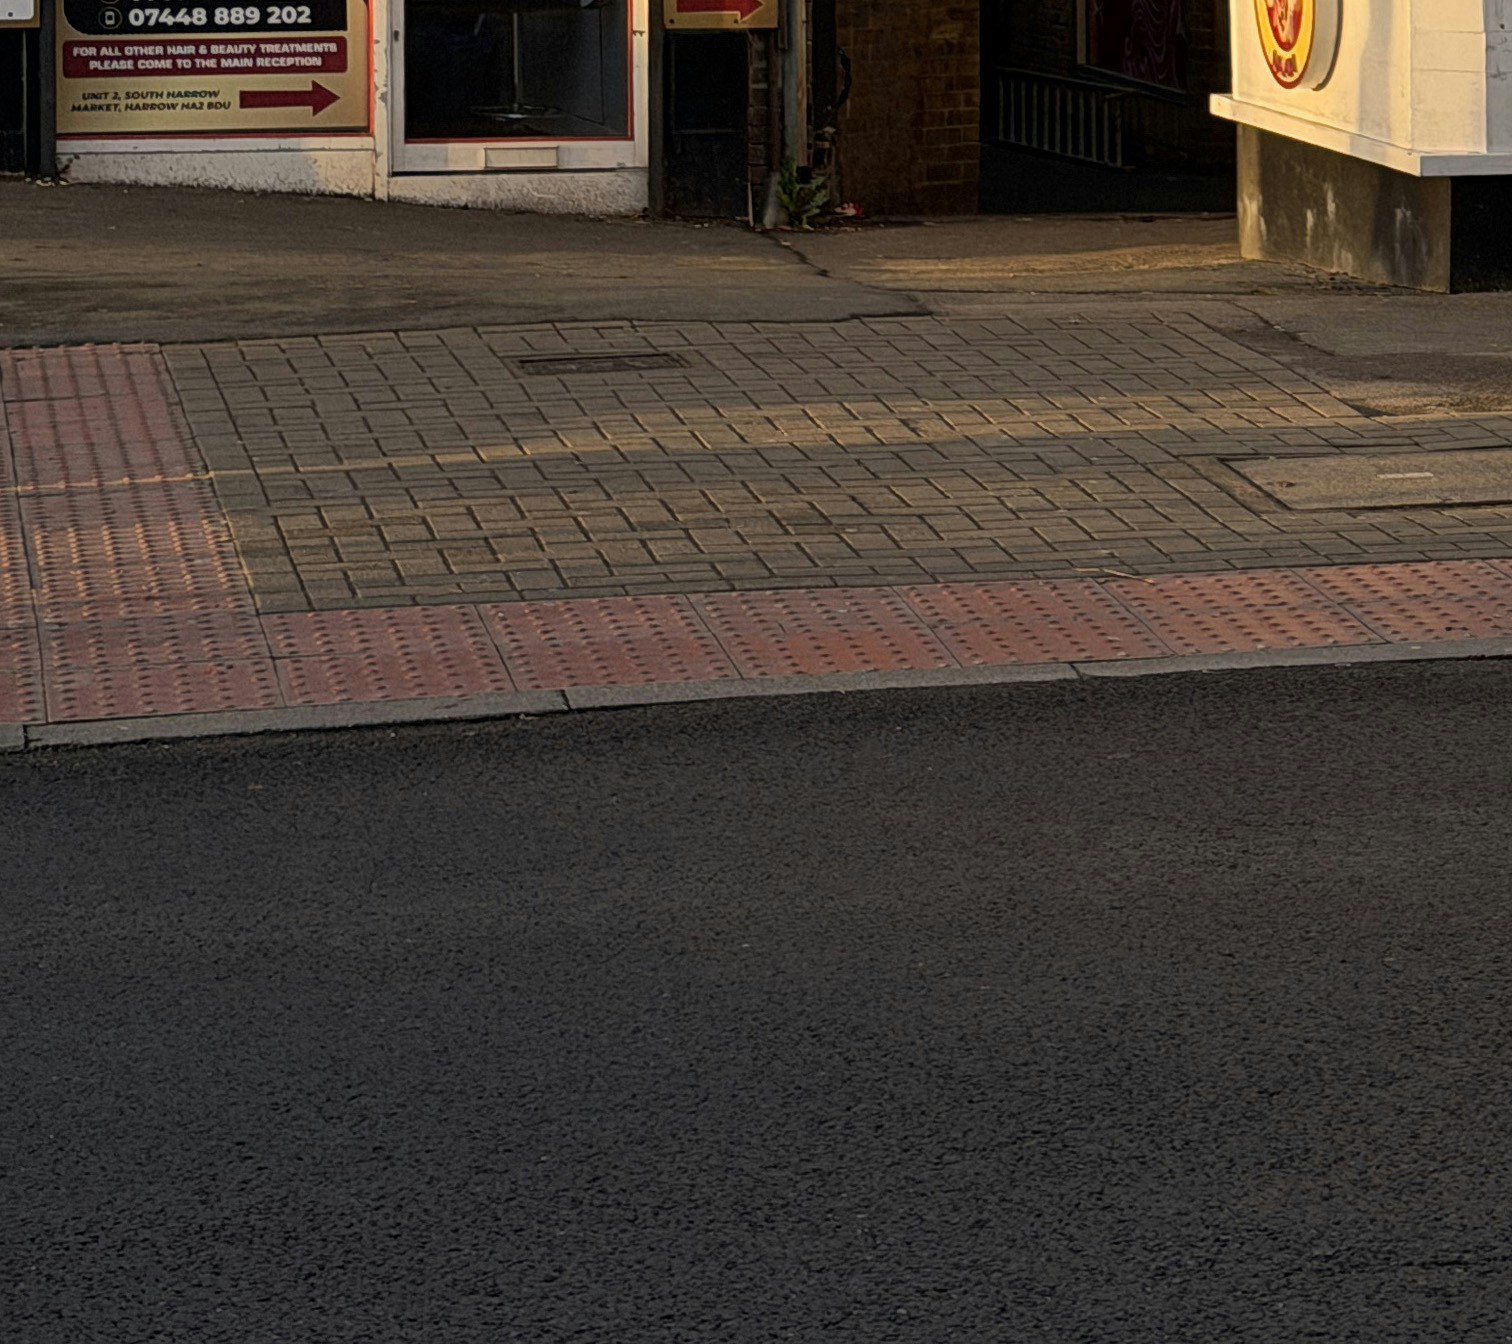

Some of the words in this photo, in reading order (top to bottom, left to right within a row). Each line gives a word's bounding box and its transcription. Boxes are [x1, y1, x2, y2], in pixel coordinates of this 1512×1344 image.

[128, 7, 207, 26] 07448
[214, 7, 260, 25] 889
[267, 6, 312, 24] 202
[73, 46, 97, 57] FOR
[100, 46, 121, 56] ALL
[124, 45, 164, 56] OTHER
[167, 45, 195, 55] HAIR
[211, 44, 256, 55] BEAUTY
[259, 43, 337, 54] TREATMENTS
[89, 59, 134, 70] PLEASE
[137, 59, 172, 70] COME
[176, 59, 191, 69] TO
[195, 58, 217, 69] THE
[221, 58, 253, 68] MAIN
[256, 57, 322, 68] RECEPTION
[125, 90, 164, 100] SOUTH
[166, 89, 220, 99] HARROW
[71, 103, 122, 113] MARKET,
[125, 102, 178, 112] HARROW
